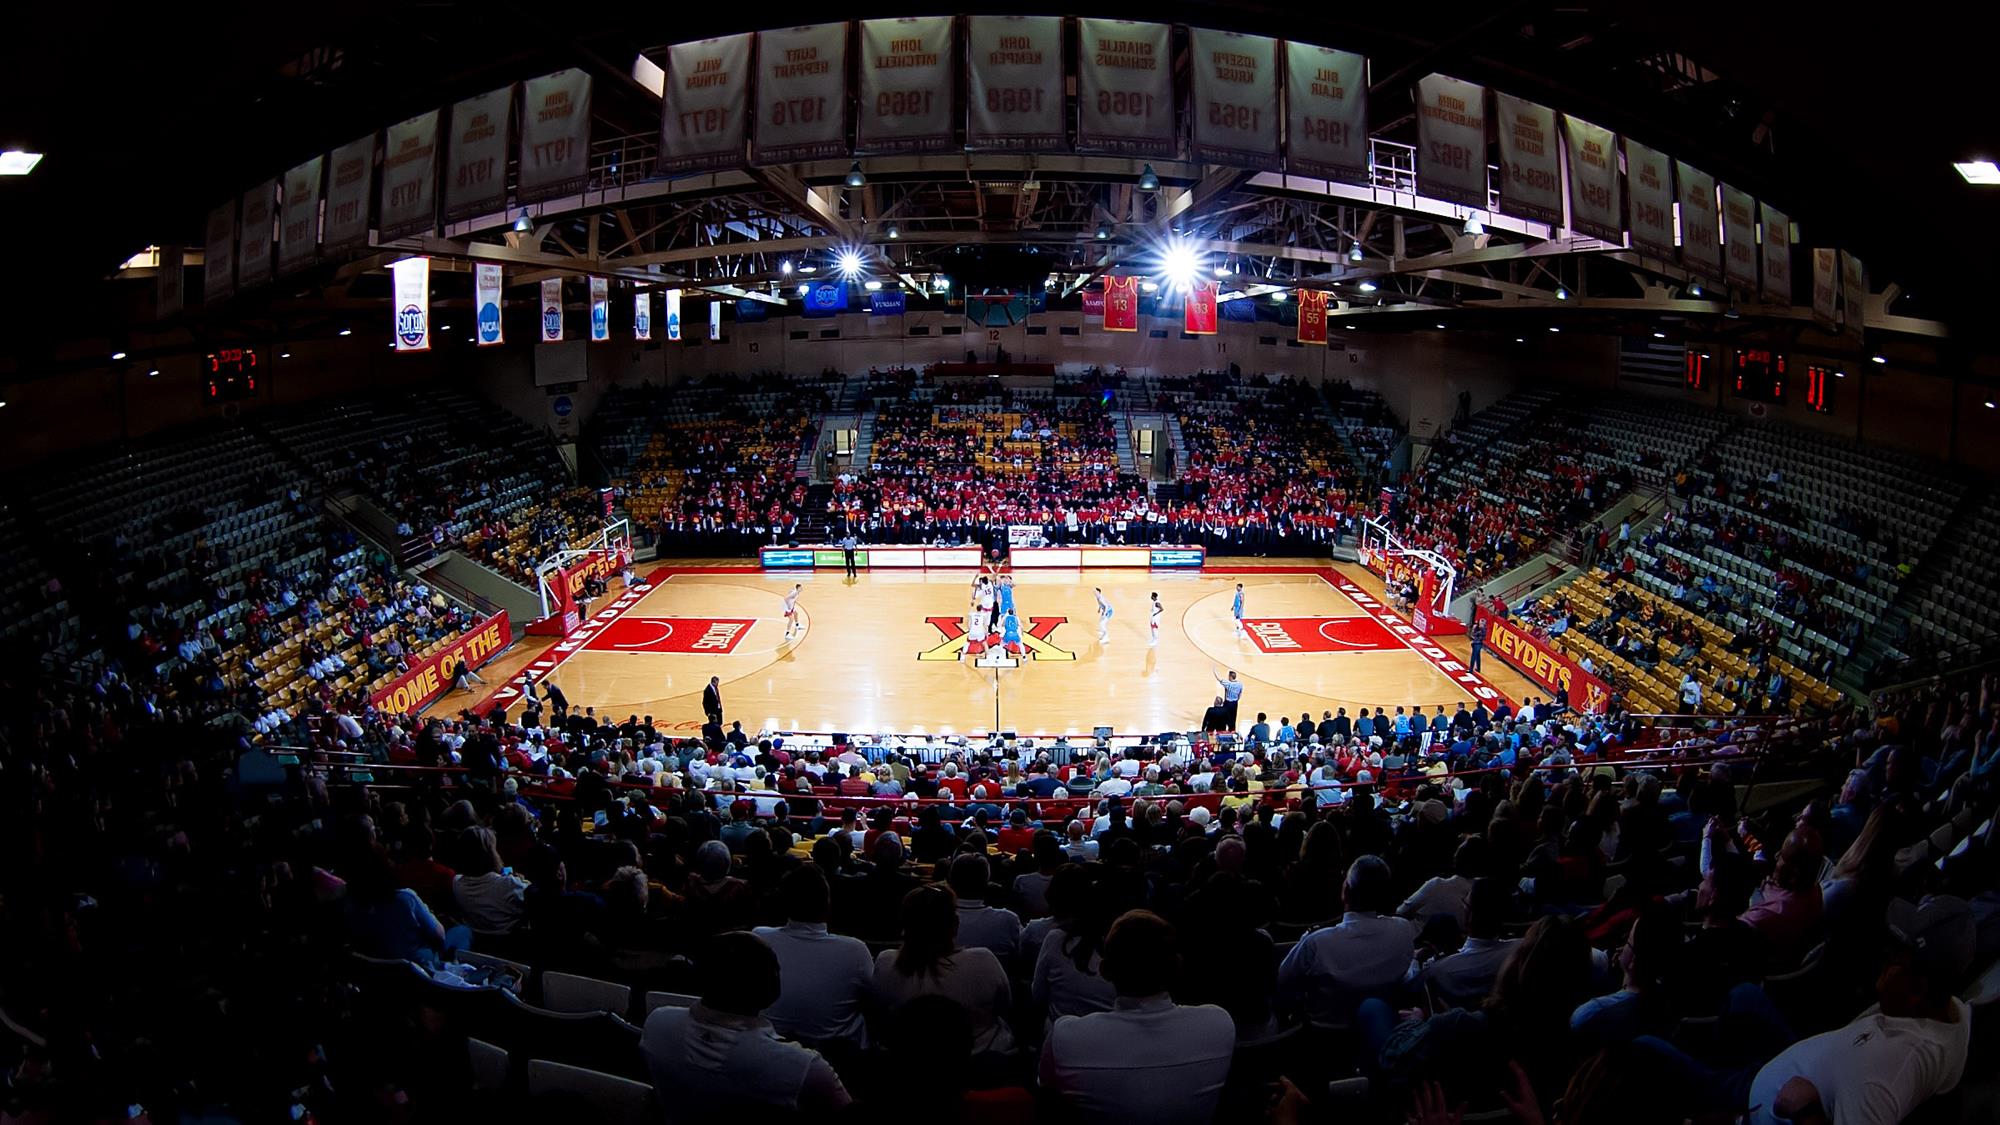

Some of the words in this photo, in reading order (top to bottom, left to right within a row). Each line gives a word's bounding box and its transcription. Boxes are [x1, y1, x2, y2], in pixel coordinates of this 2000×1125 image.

[875, 300, 901, 309] FURMAN
[1113, 300, 1128, 312] 13
[399, 313, 426, 336] SOCON
[1306, 312, 1320, 324] 55
[989, 330, 1000, 341] 12
[749, 342, 759, 353] 13
[1218, 343, 1227, 352] 11
[984, 588, 992, 596] 15
[493, 659, 557, 700] VMI
[555, 583, 652, 652] KEYDETS
[691, 622, 746, 650] SOCON
[1246, 622, 1302, 649] SOCON
[1340, 583, 1381, 609] VMI
[1380, 613, 1498, 700] KEYDETS
[1489, 621, 1572, 693] KEYDETS
[377, 664, 440, 714] HOME
[440, 647, 465, 681] OF
[466, 622, 502, 661] THE
